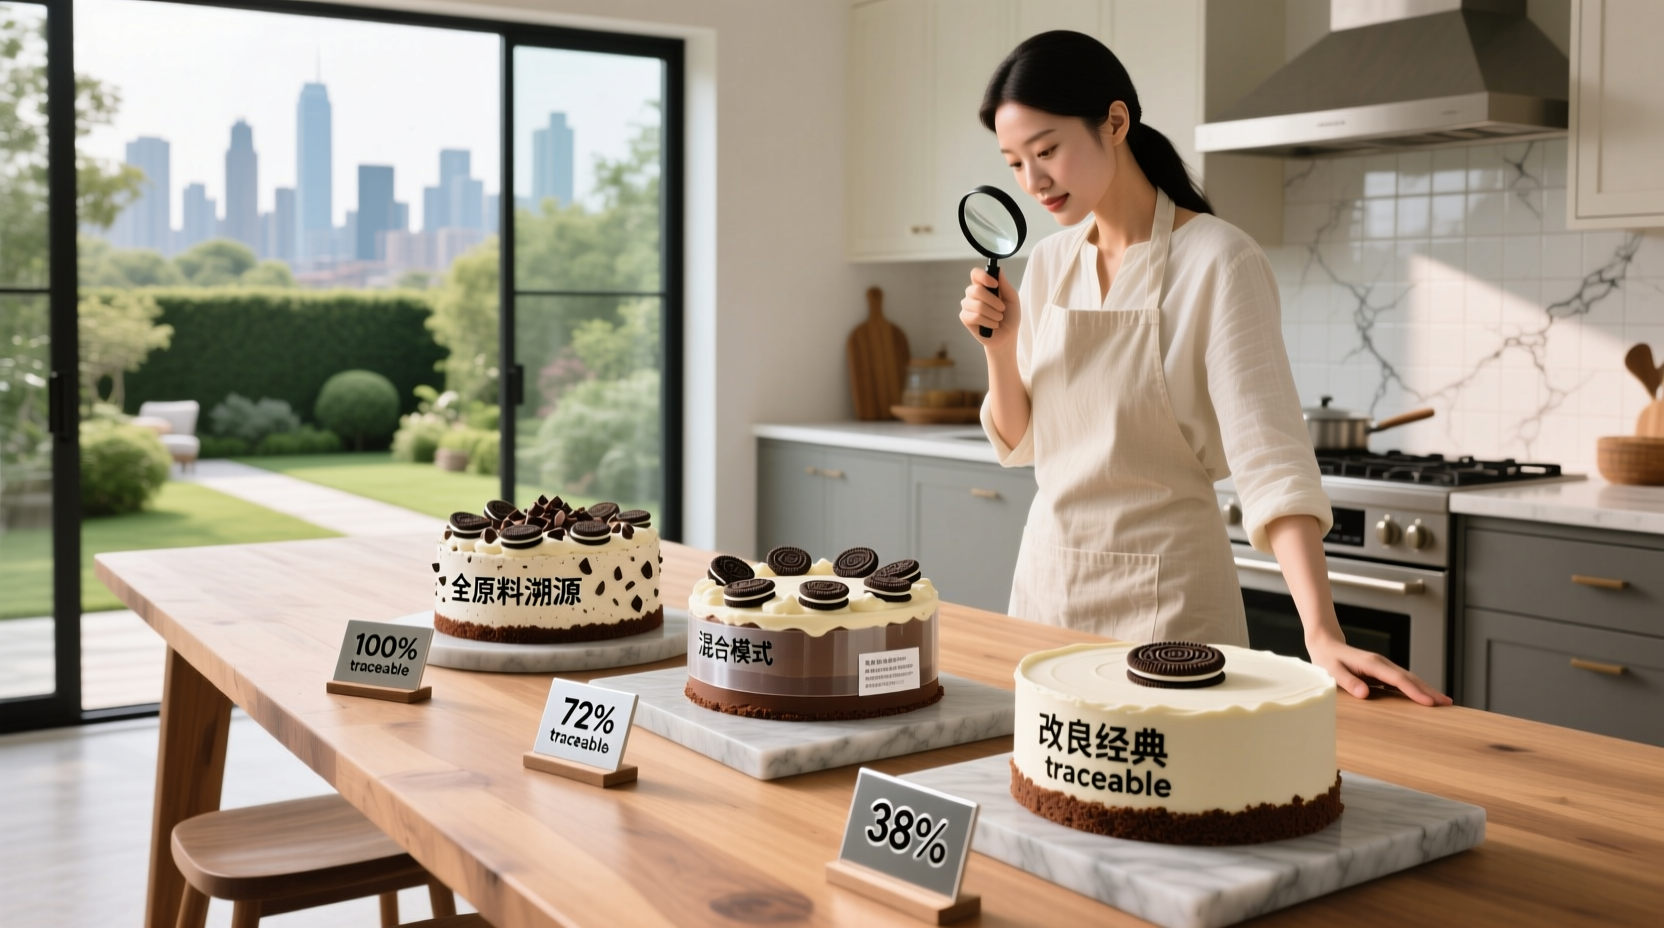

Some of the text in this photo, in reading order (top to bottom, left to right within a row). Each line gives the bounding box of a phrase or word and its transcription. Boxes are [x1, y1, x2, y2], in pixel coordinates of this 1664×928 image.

[355, 632, 418, 661] 100%
[698, 630, 774, 666] 混合模式
[350, 658, 410, 677] traceable
[560, 697, 615, 735] 72%
[549, 728, 610, 754] traceable
[1038, 713, 1168, 768] 改良经典
[1045, 755, 1172, 797] traceable
[866, 800, 947, 866] 38%
